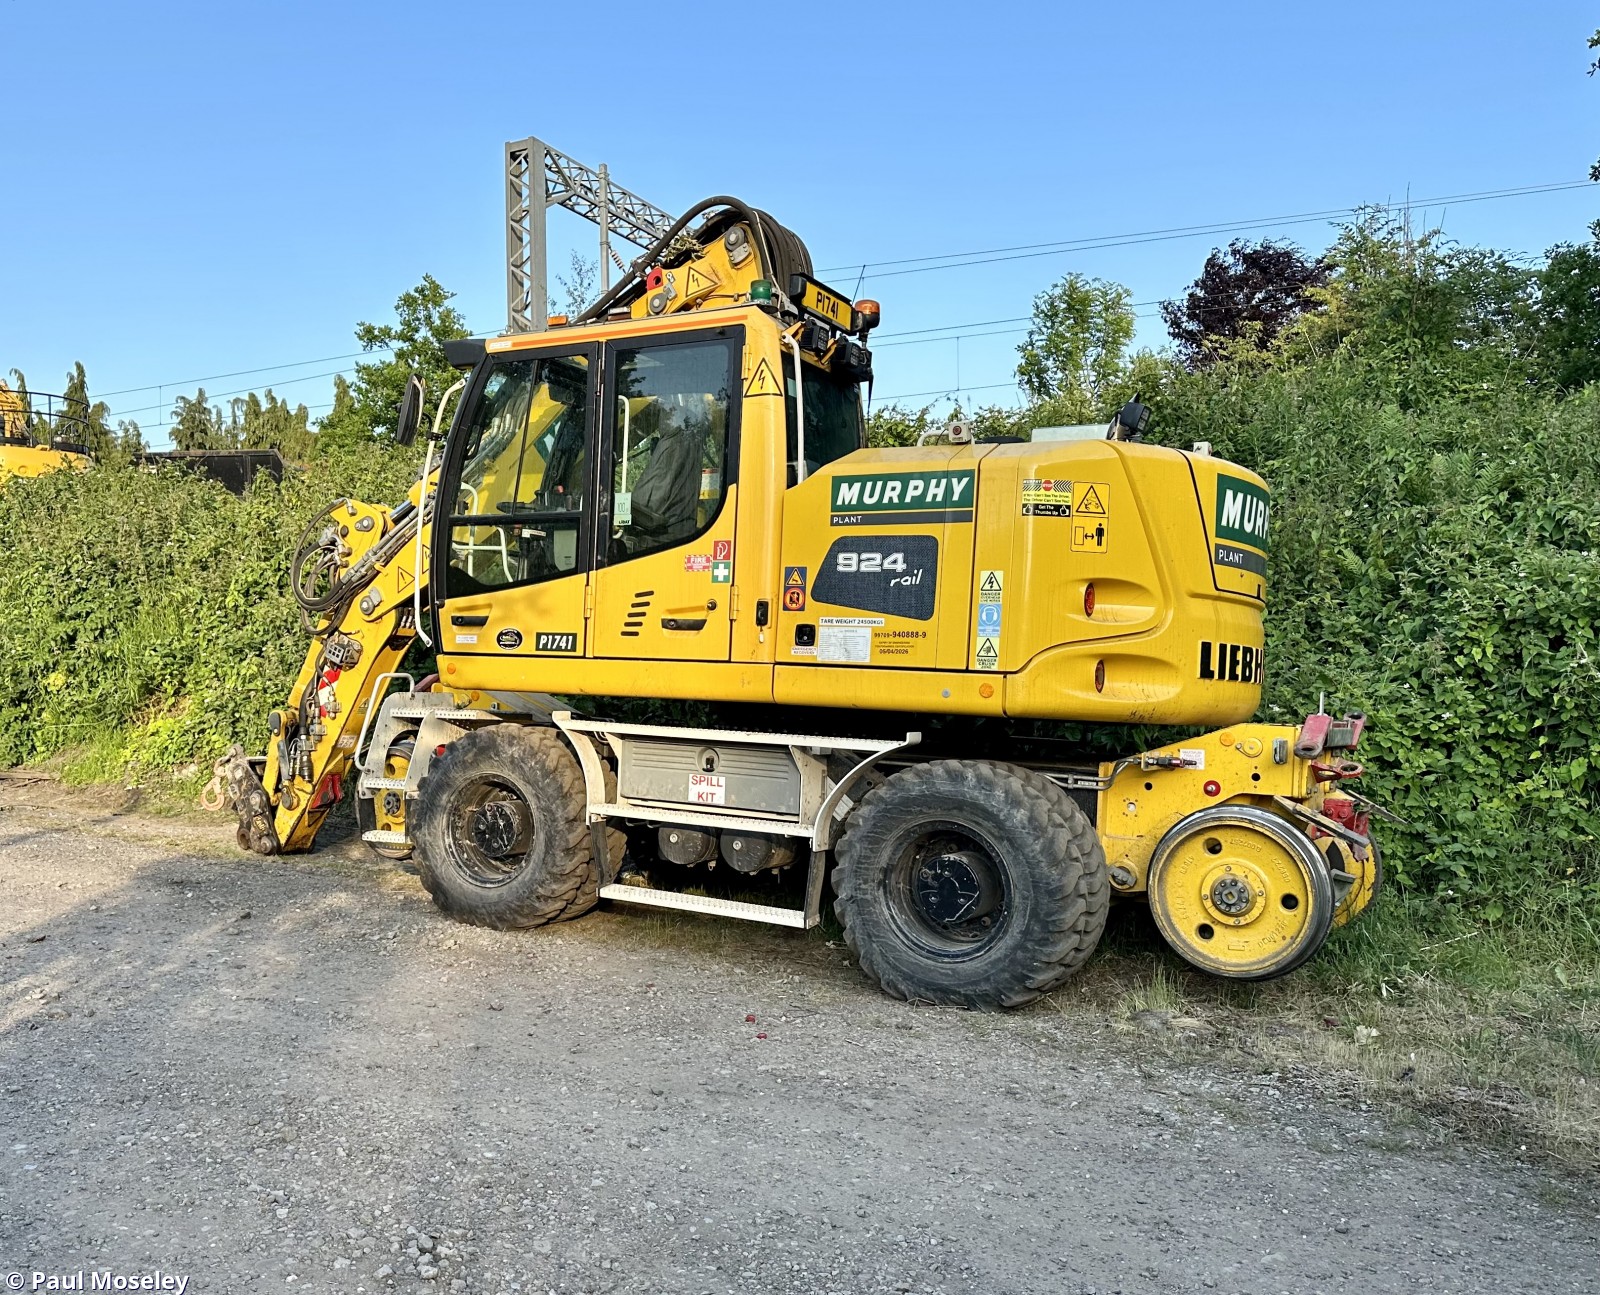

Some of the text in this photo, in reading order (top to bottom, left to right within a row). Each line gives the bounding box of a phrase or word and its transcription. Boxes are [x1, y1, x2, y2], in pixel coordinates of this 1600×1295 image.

[815, 291, 839, 319] P1741
[836, 476, 971, 505] MURPHY
[833, 516, 862, 524] PLANT
[836, 552, 907, 573] 924
[1218, 549, 1243, 564] PLANT
[890, 568, 923, 587] rail
[539, 634, 573, 650] P1741
[691, 775, 723, 787] SPILL
[697, 791, 716, 803] KIT
